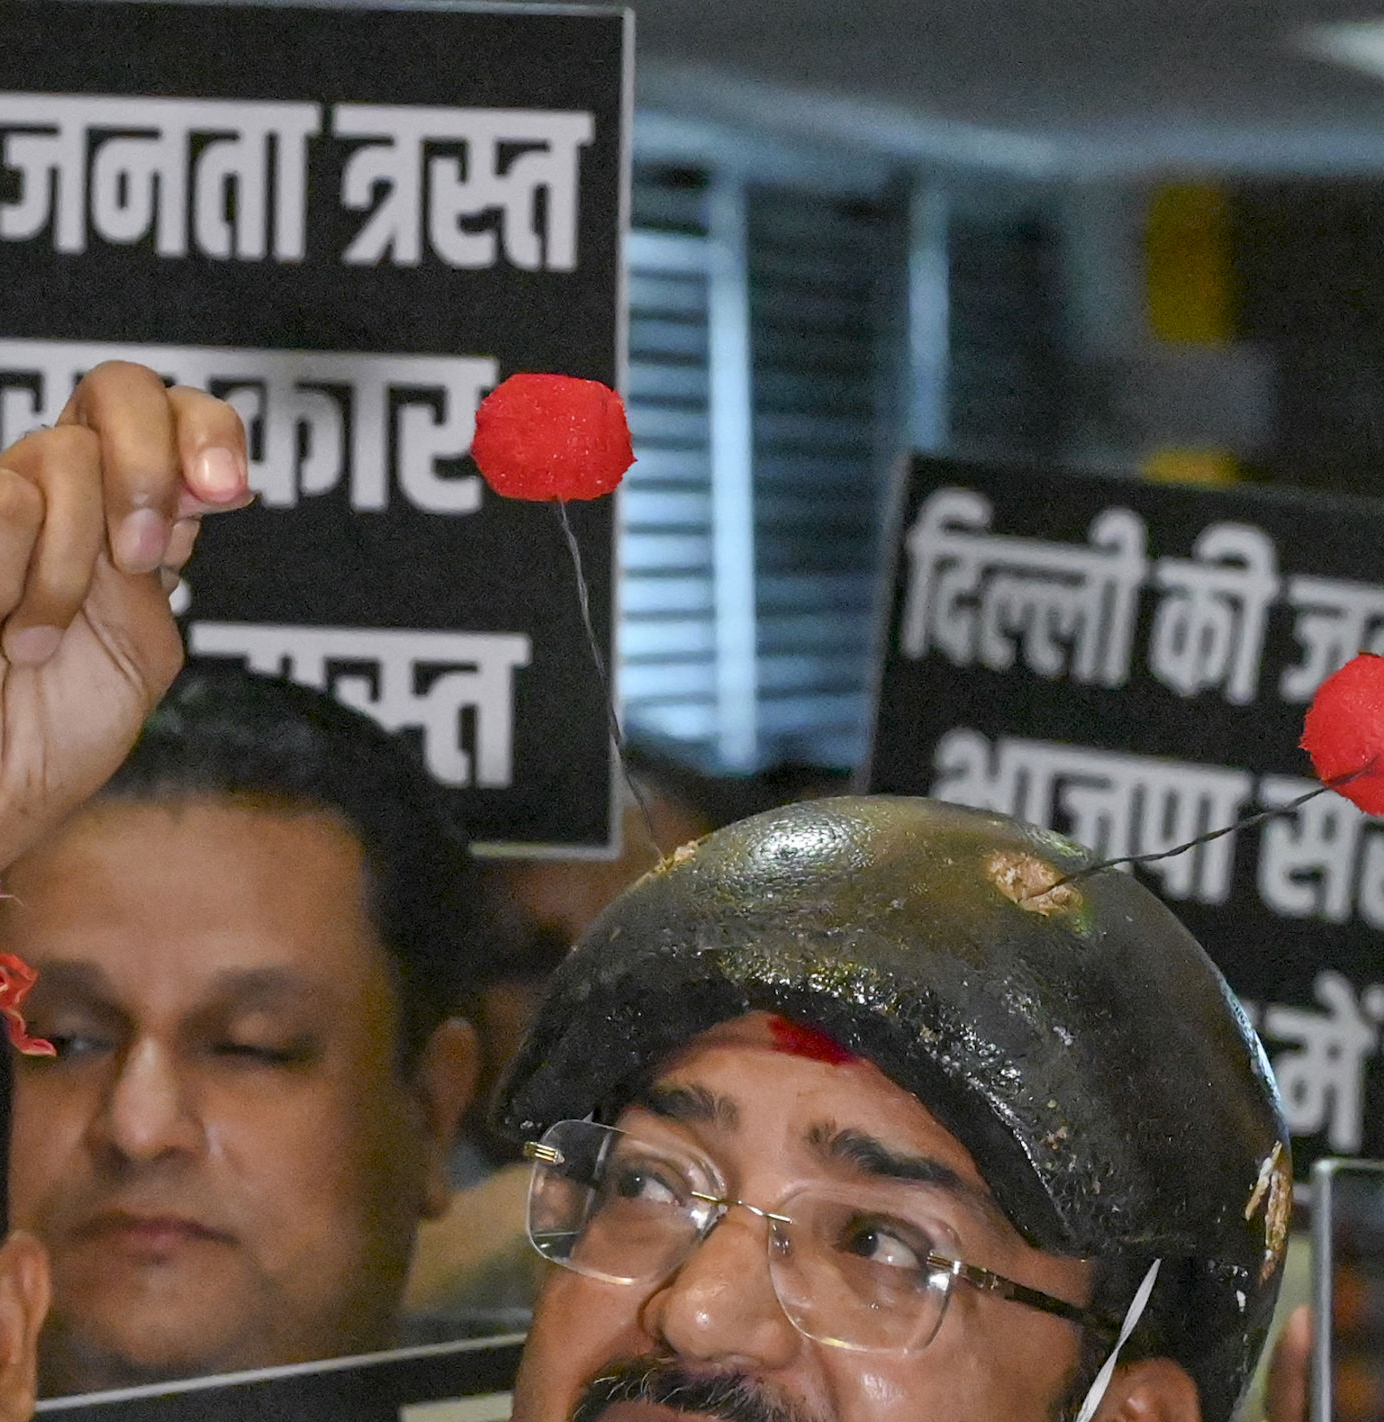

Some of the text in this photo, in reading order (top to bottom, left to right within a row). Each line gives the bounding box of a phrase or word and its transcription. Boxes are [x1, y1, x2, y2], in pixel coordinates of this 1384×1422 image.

[334, 105, 593, 270] त्रस्त
[907, 493, 1148, 682] दिल्ली
[1153, 525, 1280, 700] की
[1272, 970, 1377, 1154] में
